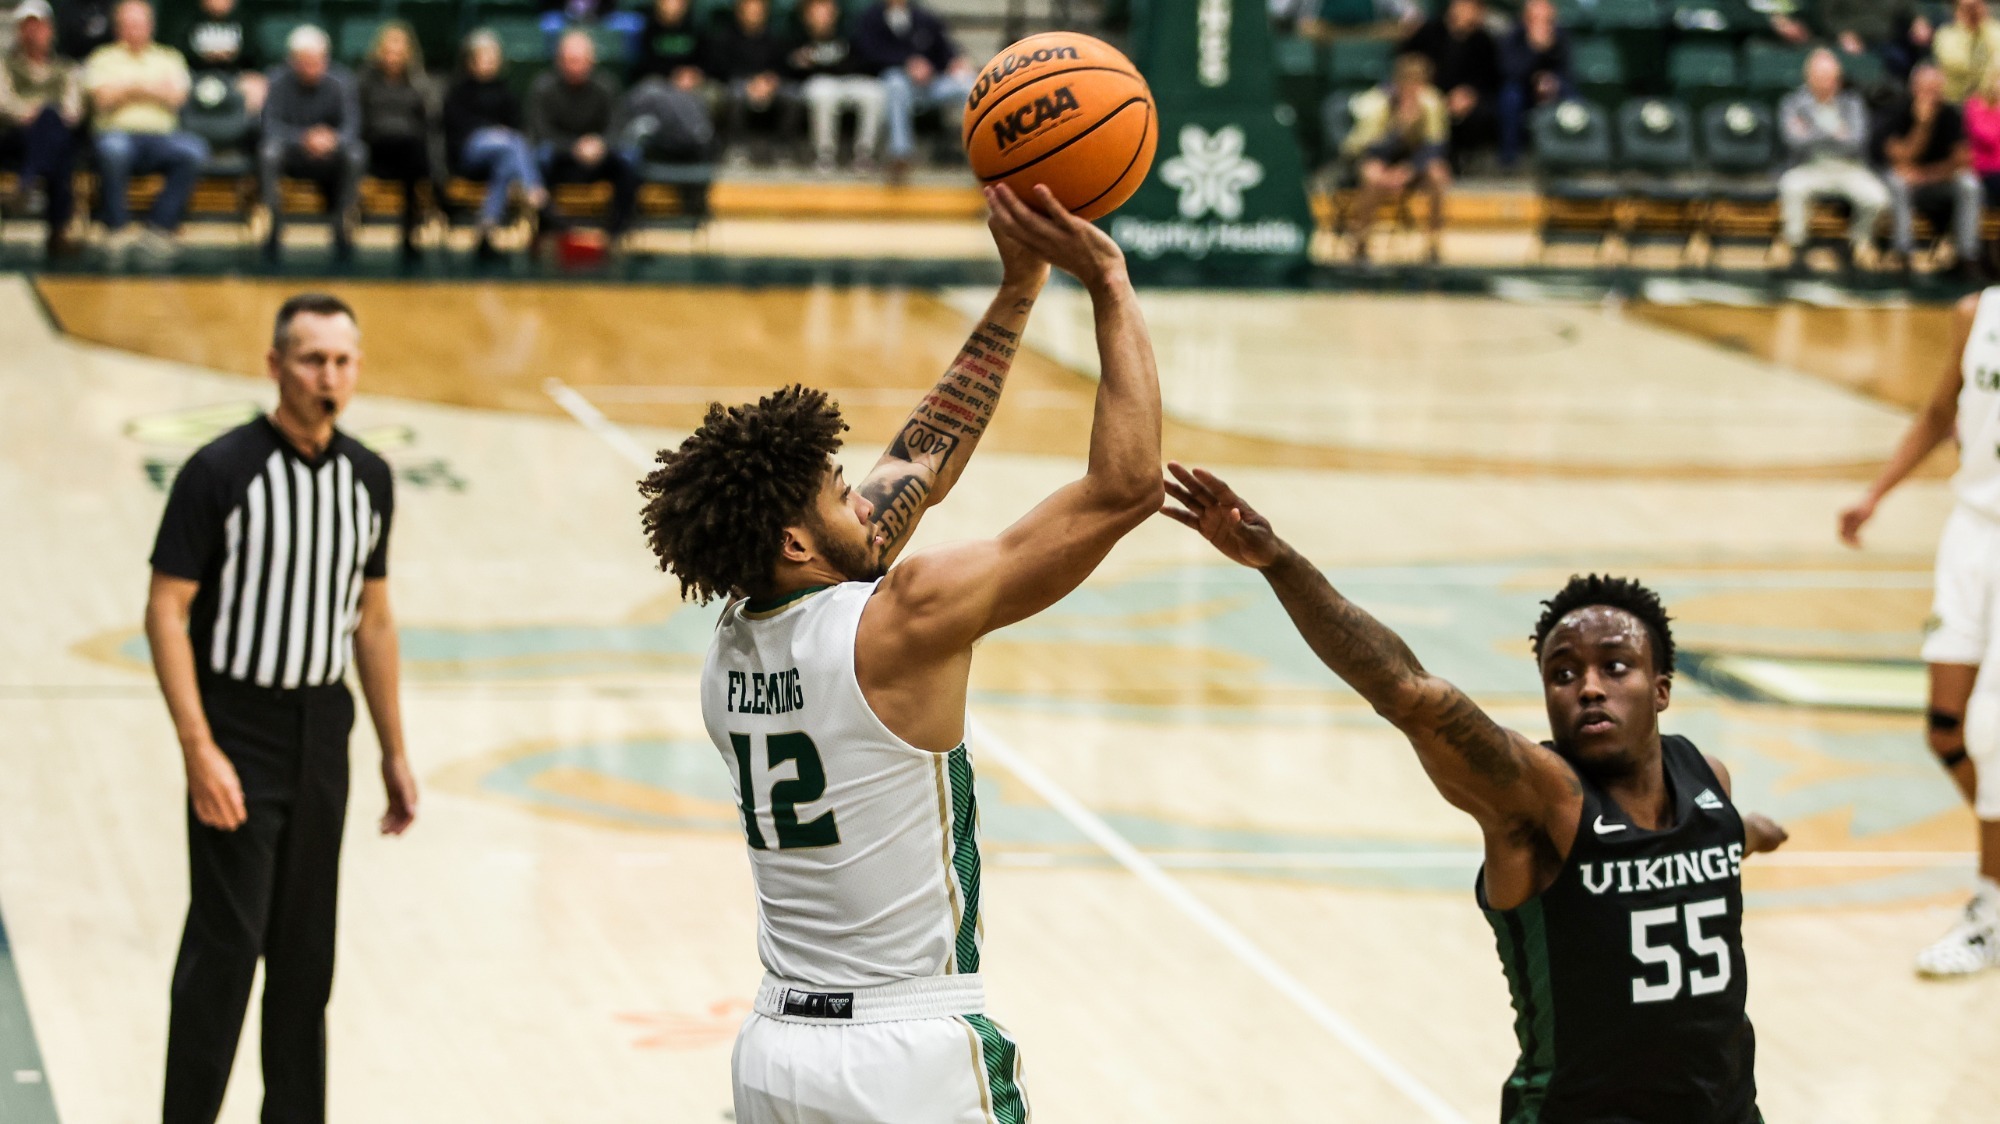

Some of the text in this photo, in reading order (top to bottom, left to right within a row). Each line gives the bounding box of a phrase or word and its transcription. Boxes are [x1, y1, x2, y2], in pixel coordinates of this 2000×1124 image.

[969, 46, 1080, 111] Wilson
[993, 86, 1079, 151] NCAA
[1113, 219, 1302, 258] Dignity Health
[965, 395, 982, 409] his
[908, 428, 947, 455] 400
[961, 424, 980, 438] God
[728, 667, 804, 715] FLEMING
[729, 730, 842, 850] 12
[1580, 842, 1743, 895] VIKINGS
[1630, 897, 1731, 1004] 55
